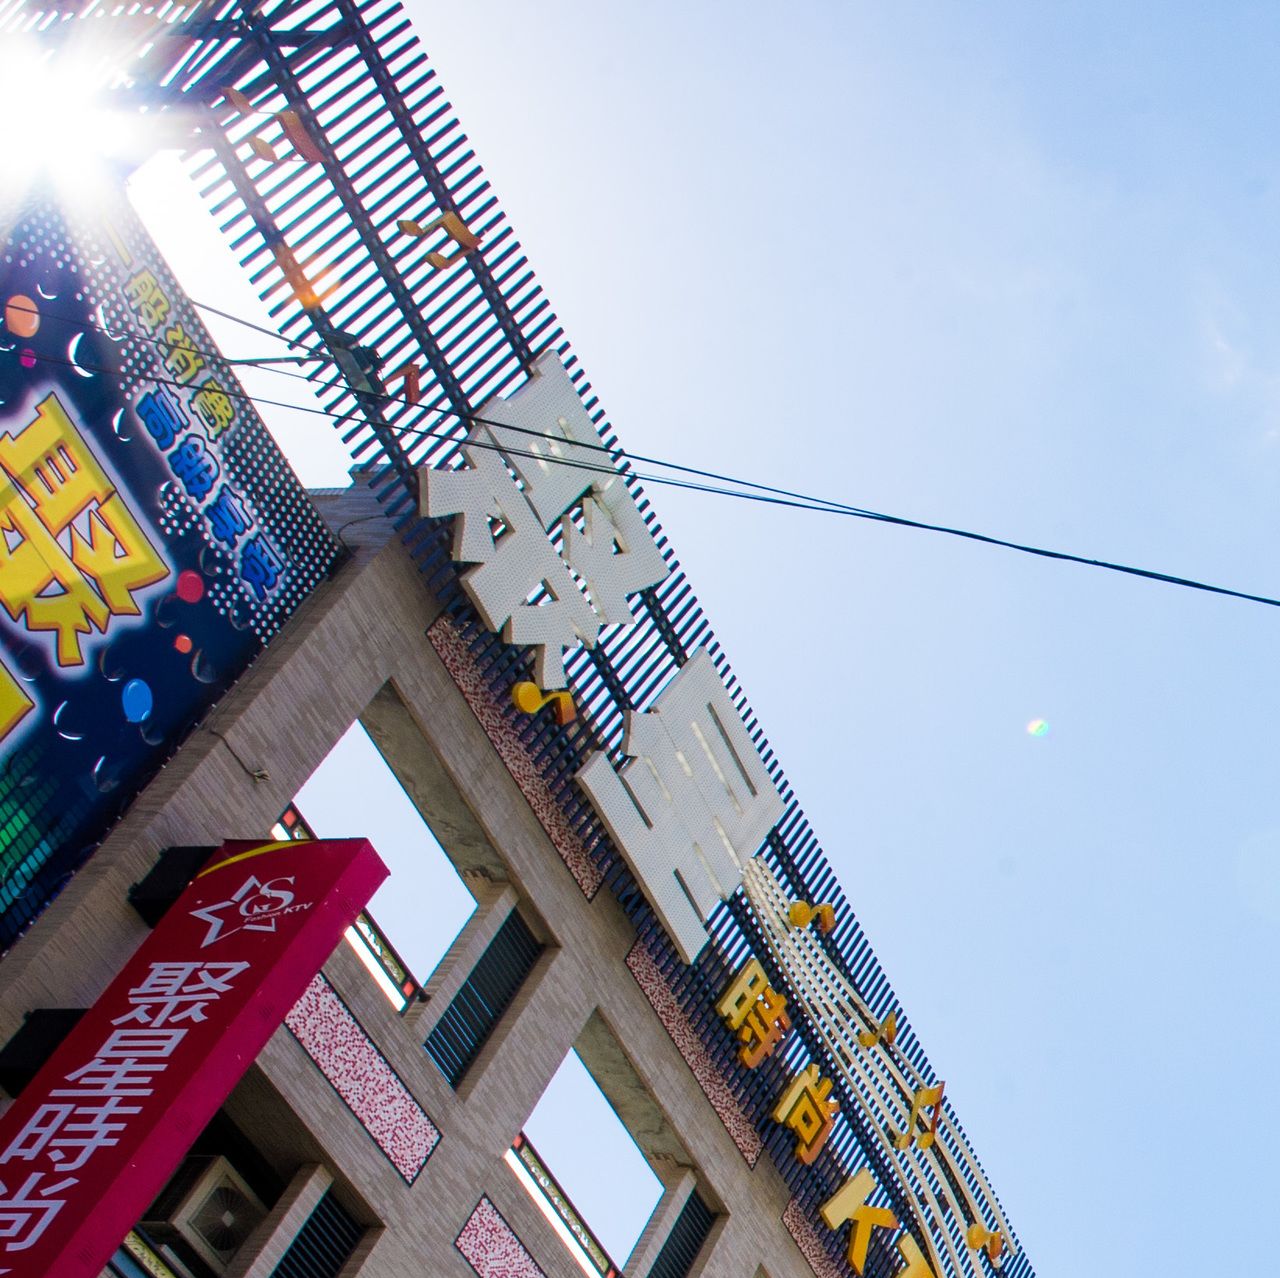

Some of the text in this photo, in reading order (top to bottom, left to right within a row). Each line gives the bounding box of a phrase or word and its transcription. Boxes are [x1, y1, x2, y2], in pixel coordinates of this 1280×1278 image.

[136, 380, 286, 602] 高級享受
[284, 902, 314, 915] KTV
[0, 961, 250, 1275] 聚星時尚
